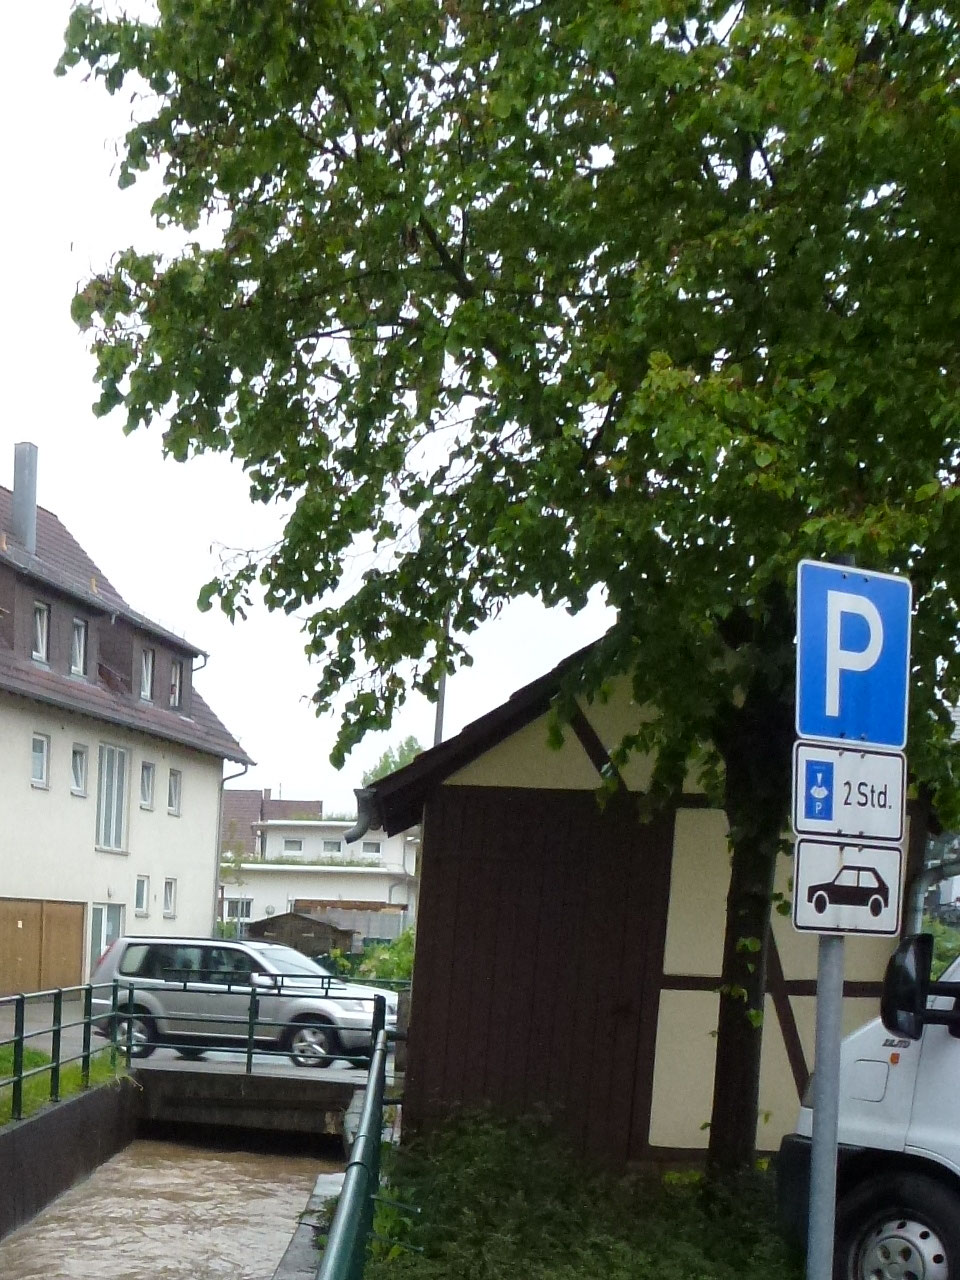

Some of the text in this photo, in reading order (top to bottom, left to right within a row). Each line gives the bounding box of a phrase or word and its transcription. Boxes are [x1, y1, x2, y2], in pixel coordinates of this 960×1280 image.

[825, 589, 884, 718] P
[843, 780, 892, 809] 2 Std.
